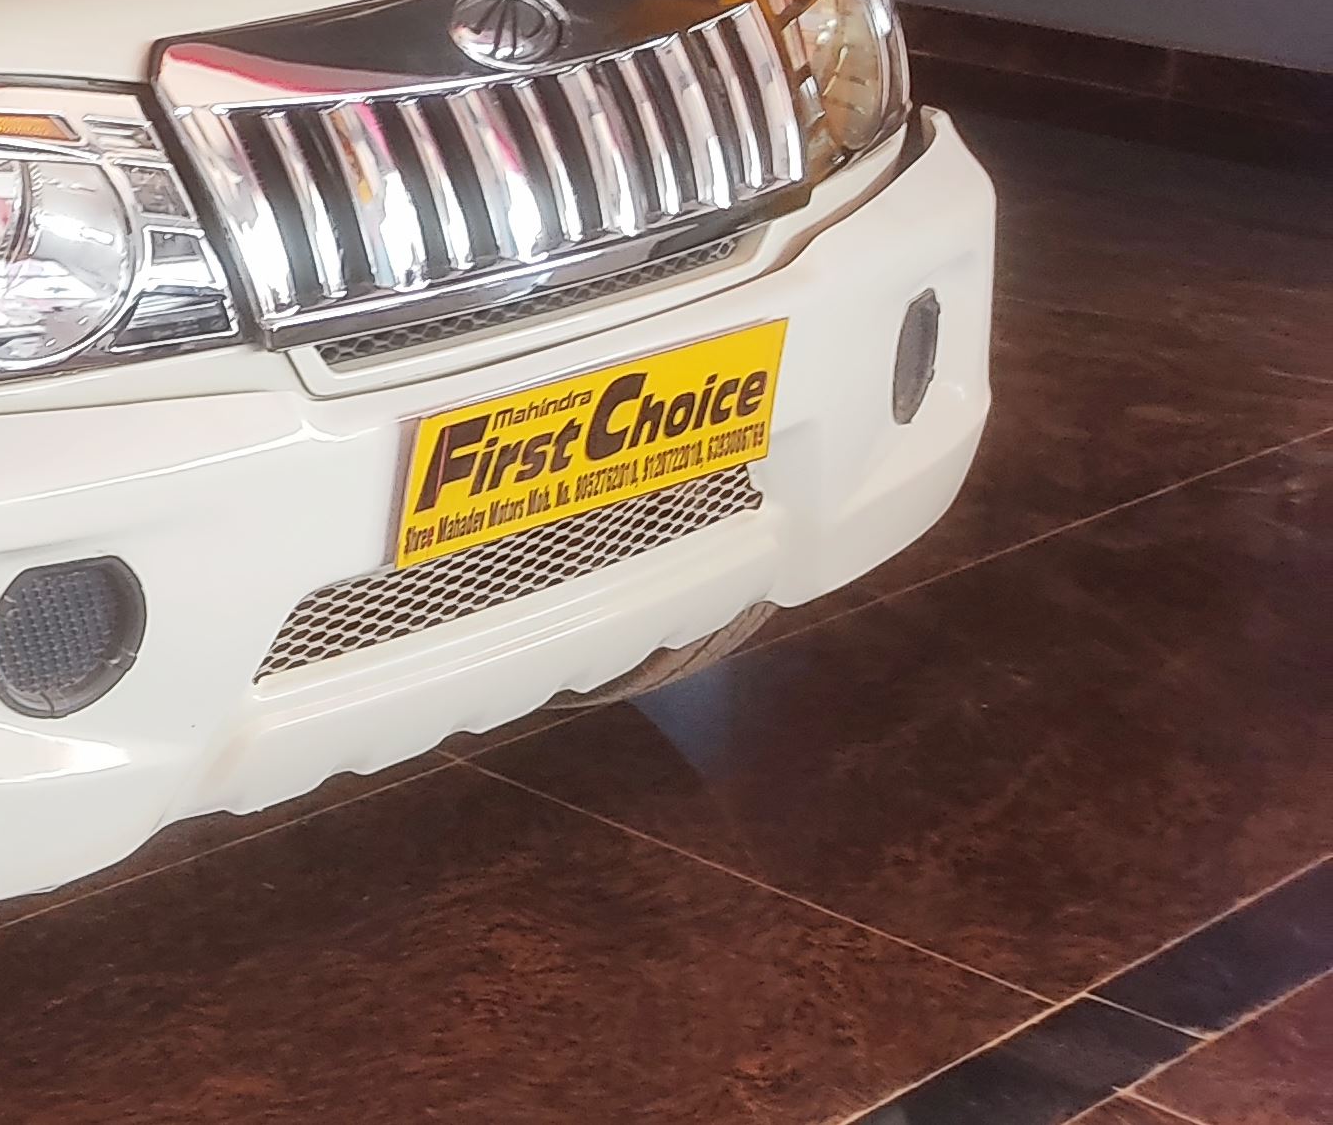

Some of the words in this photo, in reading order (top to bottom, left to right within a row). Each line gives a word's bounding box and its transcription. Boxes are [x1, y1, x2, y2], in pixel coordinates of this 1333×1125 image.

[414, 413, 585, 515] First
[585, 370, 768, 461] Choice
[491, 389, 593, 431] Mahindra
[404, 526, 435, 555] Shree
[436, 507, 486, 544] Mahadev
[487, 497, 526, 528] Motors
[526, 485, 551, 517] Mob.
